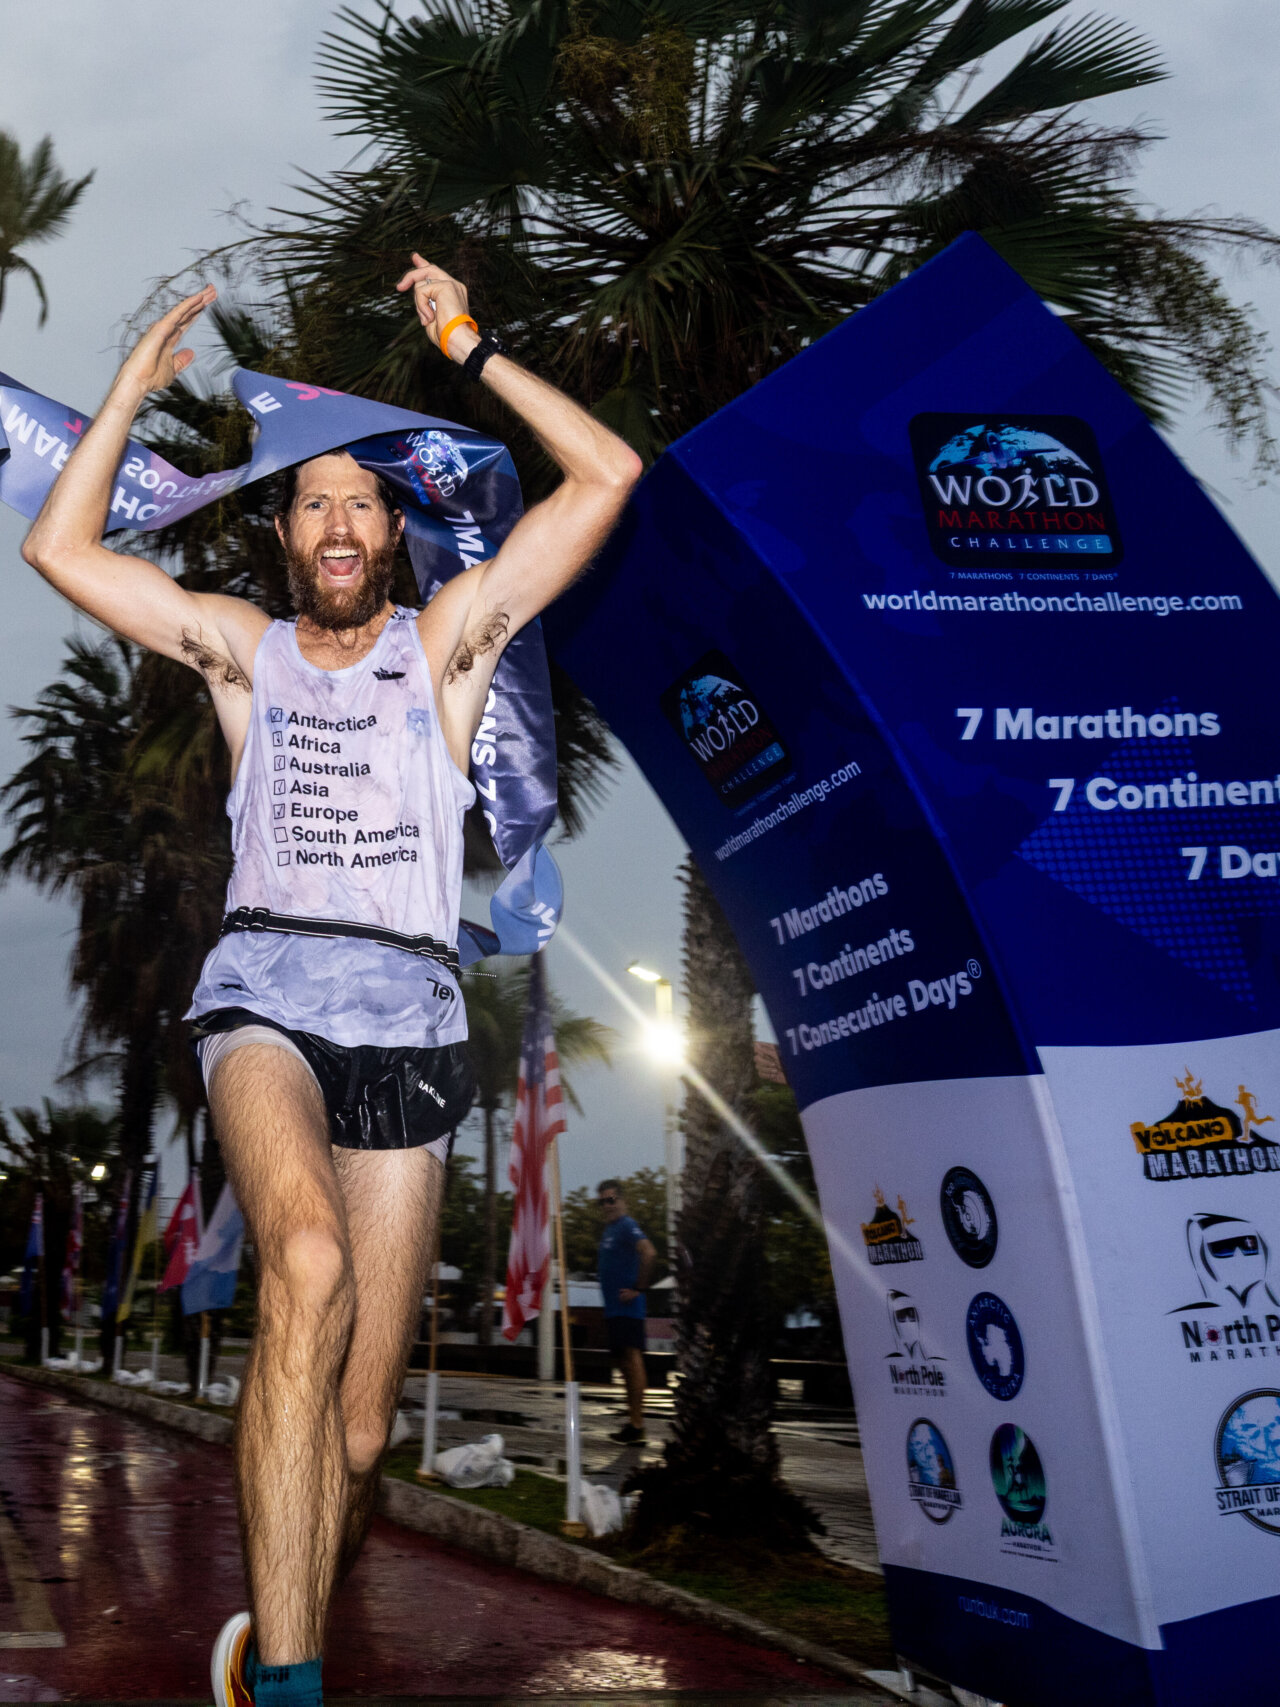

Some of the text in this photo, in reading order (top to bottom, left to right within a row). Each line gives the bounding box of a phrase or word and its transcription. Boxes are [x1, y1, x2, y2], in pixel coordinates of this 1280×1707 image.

[937, 509, 1108, 531] MARATHON
[950, 536, 1104, 550] CHALLENGE
[957, 572, 1013, 581] MARATHONS
[1026, 572, 1080, 581] CONTINENTS
[862, 590, 1244, 617] worldmarathonchallenge.com
[287, 710, 378, 733] Antarctica
[955, 706, 1222, 741] 7 Marathons
[288, 733, 342, 755] Africa
[289, 756, 371, 778] Australia
[720, 746, 782, 795] CHALLENGE
[289, 780, 330, 799] Asia
[1048, 777, 1076, 812] 7
[290, 802, 359, 825] Europe
[715, 760, 862, 863] worldmarathonchallenge.com
[291, 821, 420, 845] South America
[296, 845, 418, 869] North America
[1180, 846, 1209, 881] 7
[770, 872, 889, 946] 7 Marathons
[792, 928, 915, 998] 7 Continents
[785, 1028, 799, 1056] 7
[798, 991, 909, 1052] Consecutive
[1134, 1120, 1225, 1150] VOLCANO
[1145, 1145, 1280, 1179] MARATHON
[1189, 1345, 1280, 1364] MARATH
[920, 1365, 945, 1387] Pole
[1216, 1488, 1261, 1511] STRAIT
[1000, 1518, 1055, 1546] AURORA
